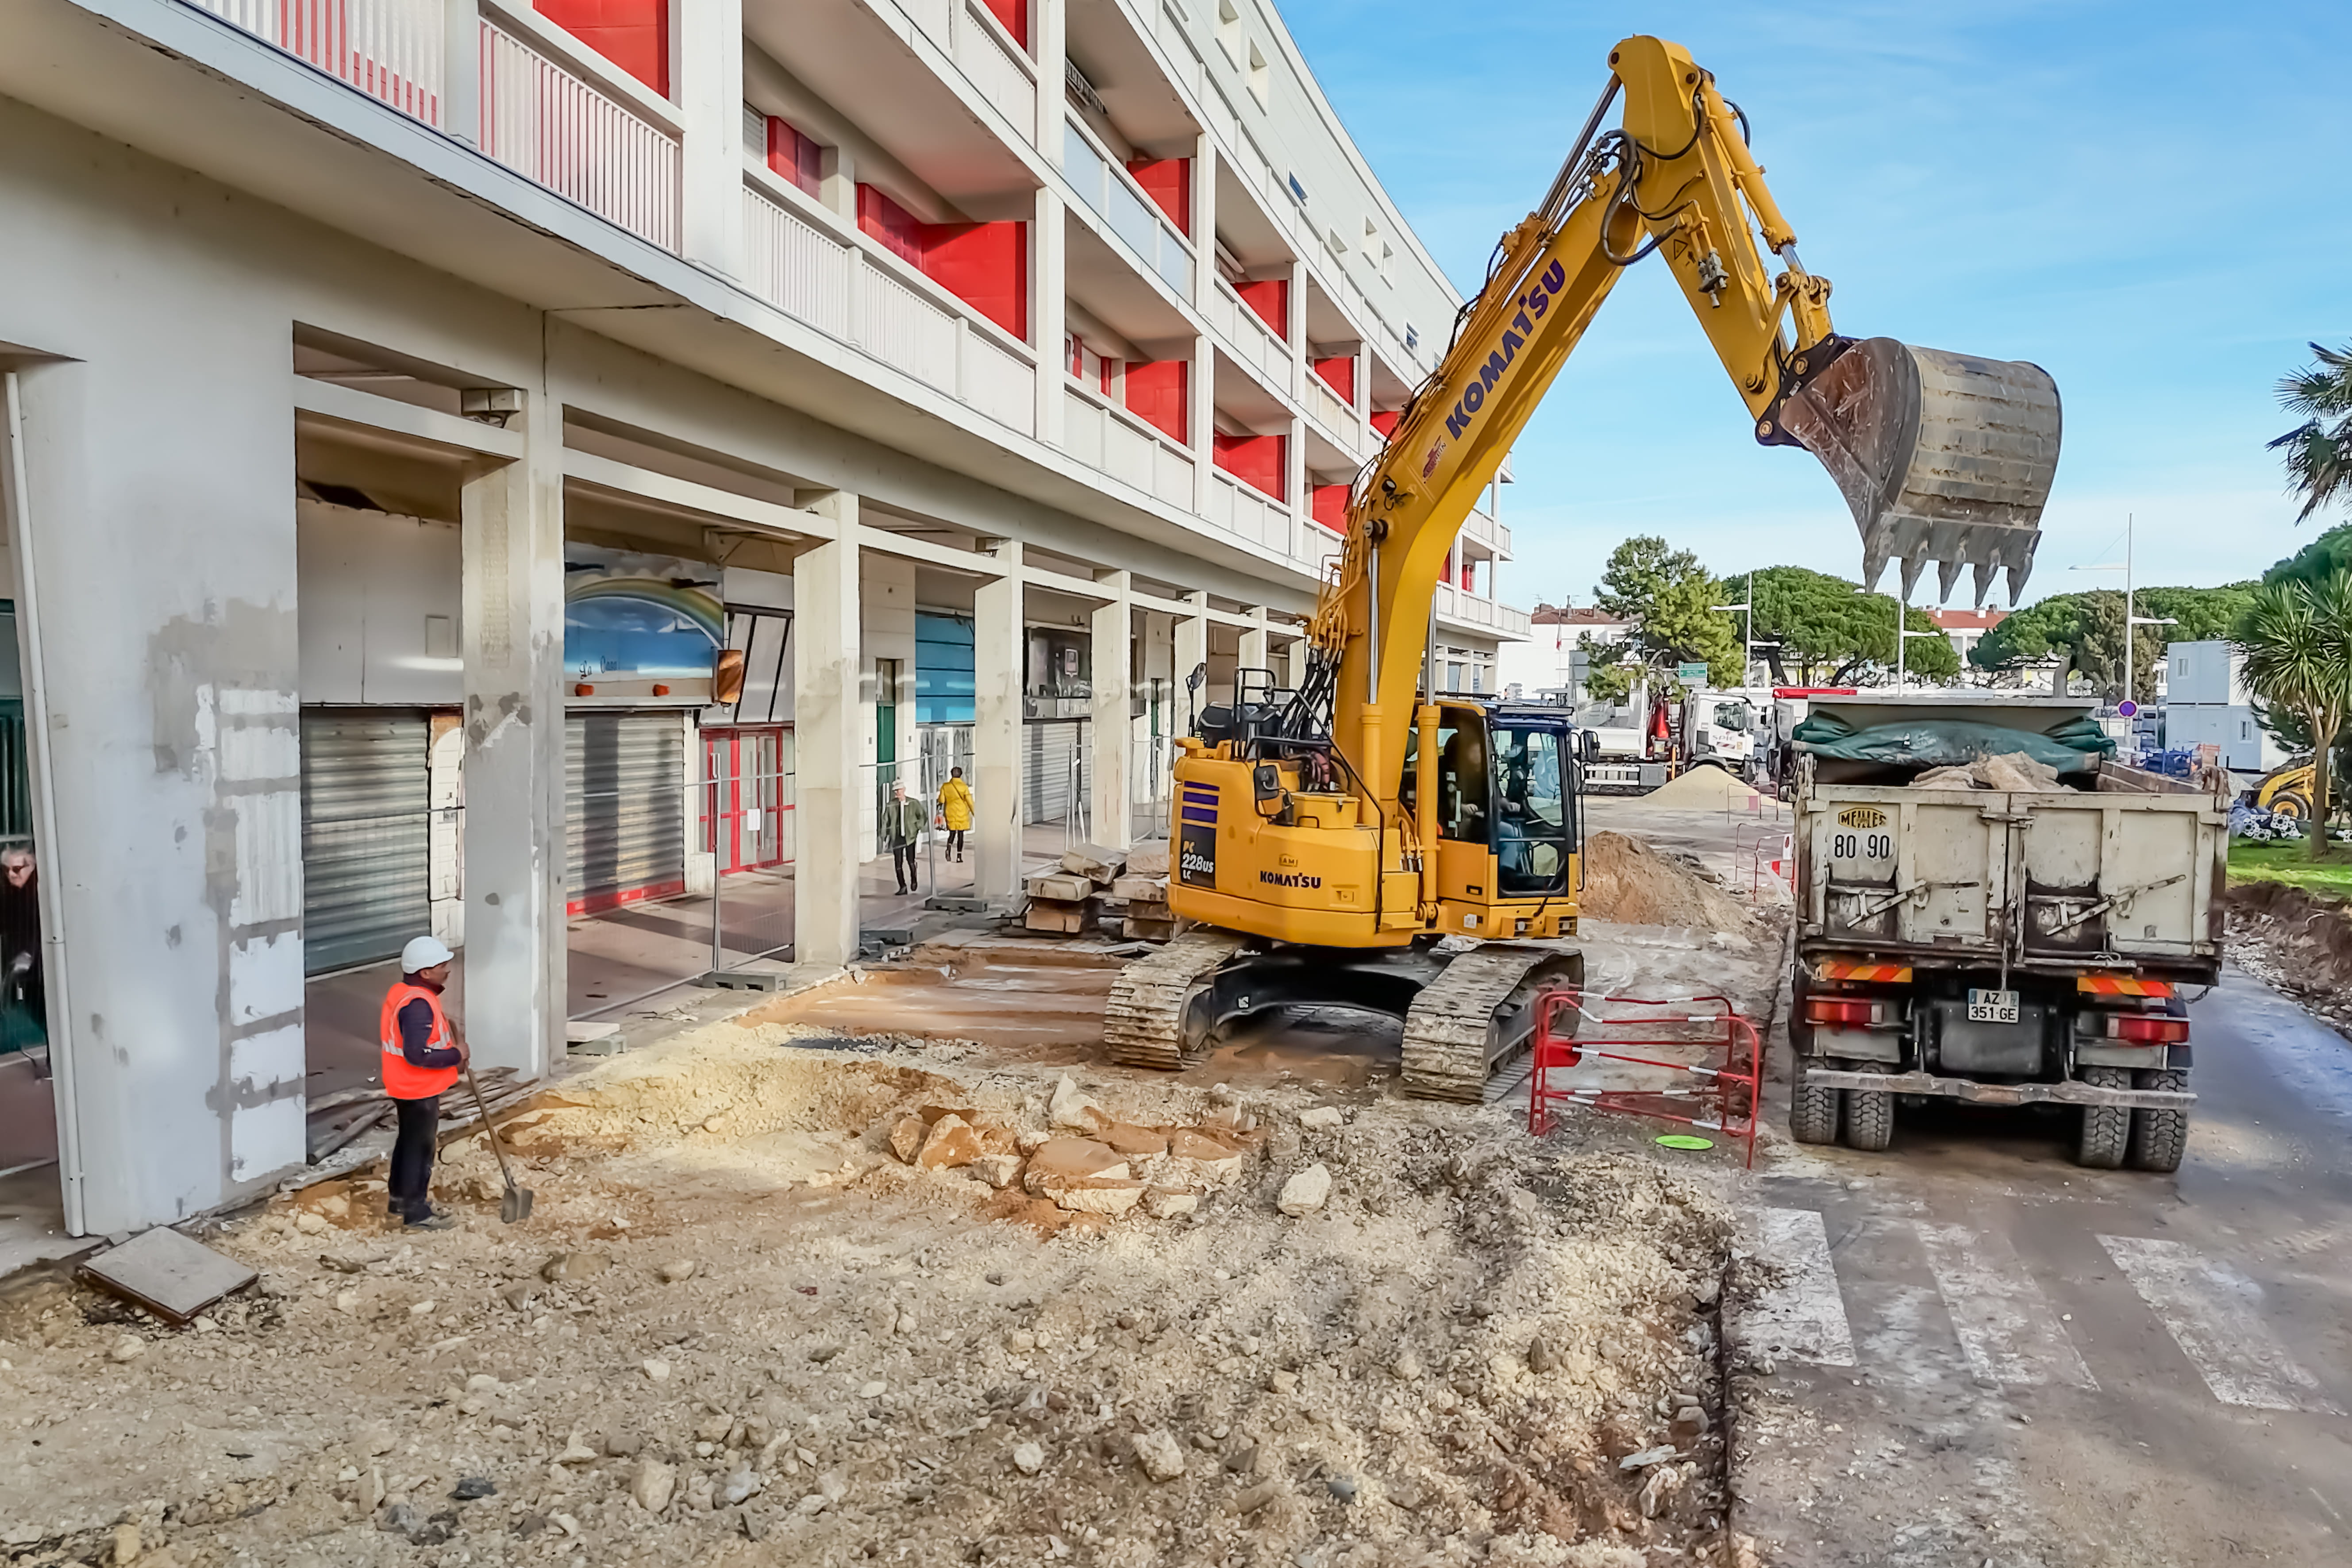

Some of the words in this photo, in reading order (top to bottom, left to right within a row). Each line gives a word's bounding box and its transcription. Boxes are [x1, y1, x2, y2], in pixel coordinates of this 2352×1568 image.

[1445, 258, 1566, 441] KOMATSU
[1183, 840, 1195, 853] PC
[1834, 834, 1856, 859] 80
[1867, 834, 1890, 859] 90
[1182, 853, 1214, 873] 228US
[1260, 871, 1321, 889] KOMATSU
[1983, 992, 2000, 1005] AZ
[1971, 1006, 2016, 1020] 351-GE
